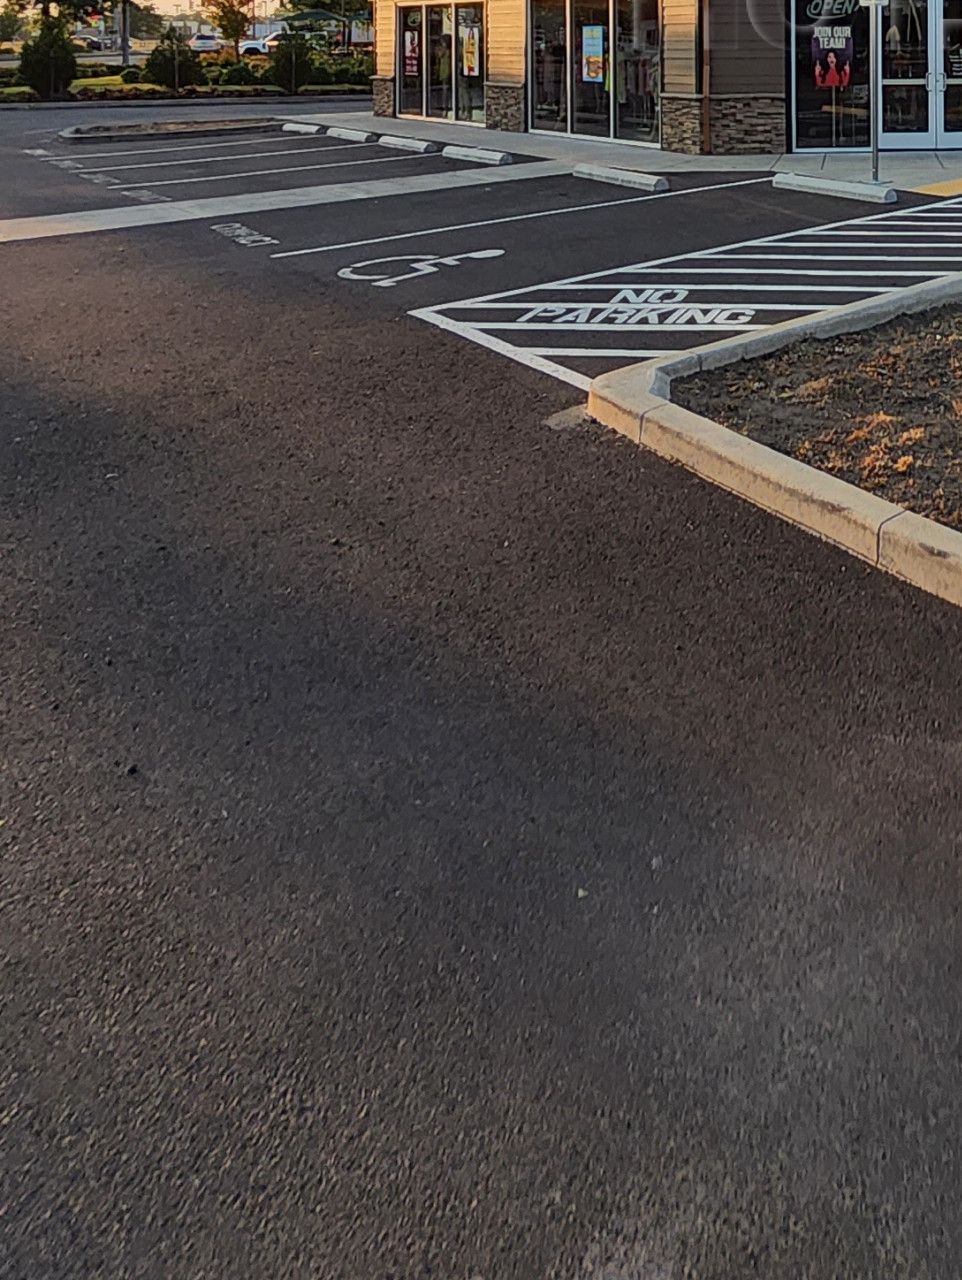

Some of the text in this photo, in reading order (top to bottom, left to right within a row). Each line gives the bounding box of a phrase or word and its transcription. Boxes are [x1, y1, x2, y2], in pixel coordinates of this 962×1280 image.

[810, 0, 855, 15] OPEN
[813, 26, 851, 38] JOIN OUR
[608, 289, 690, 304] NO
[515, 306, 756, 324] PARKING
